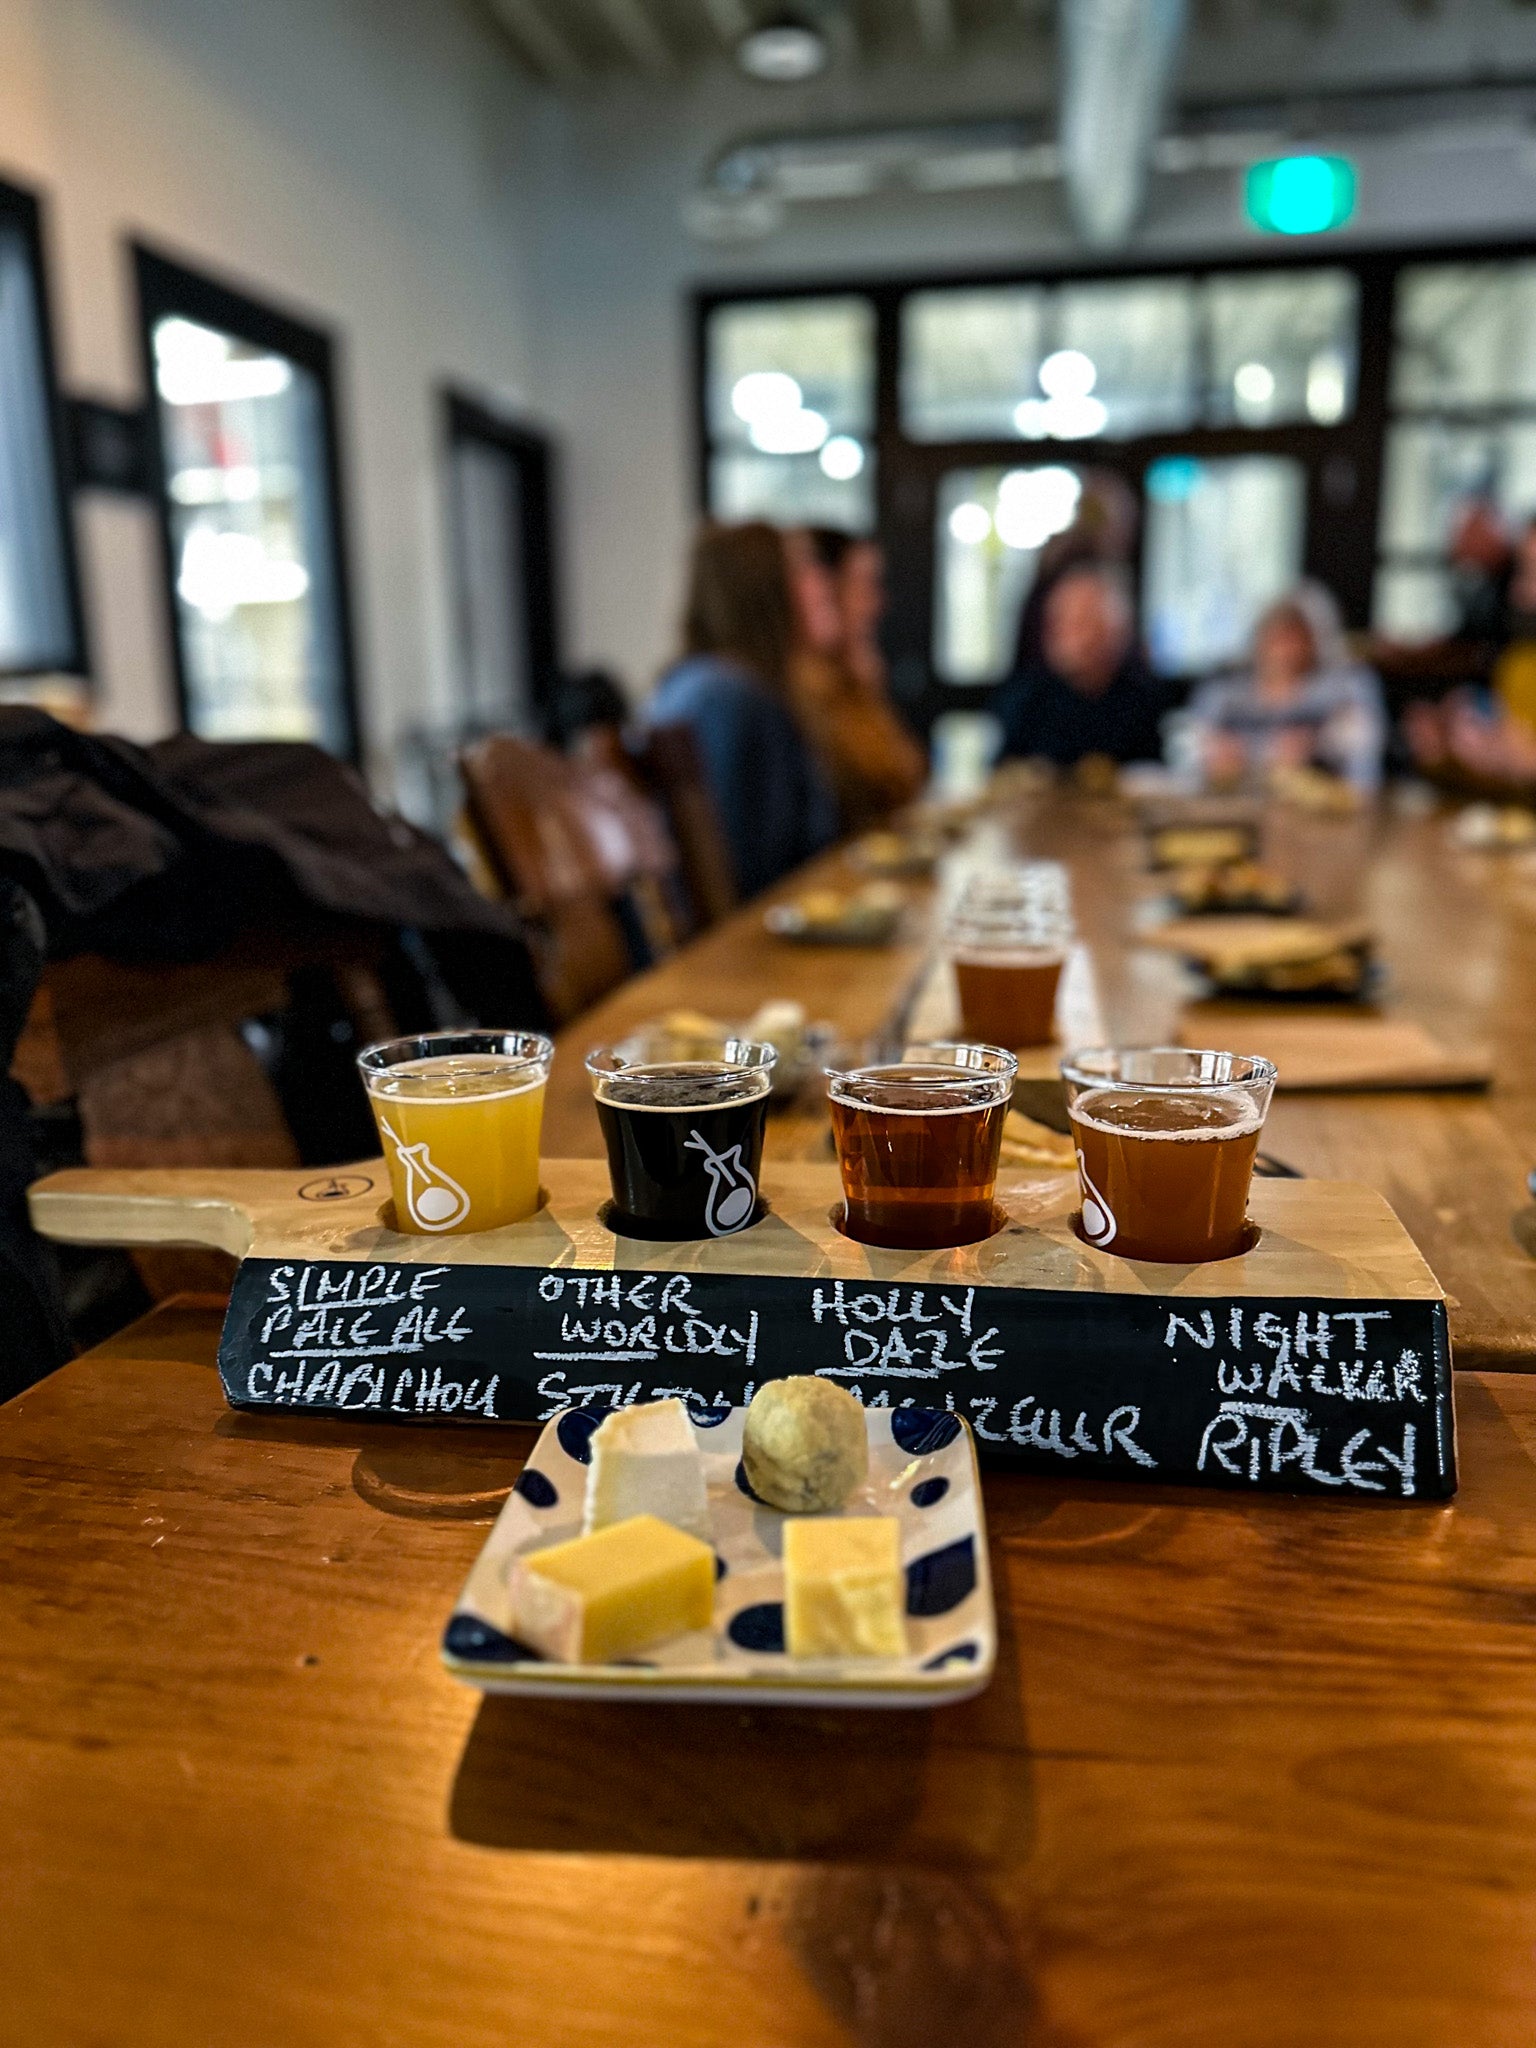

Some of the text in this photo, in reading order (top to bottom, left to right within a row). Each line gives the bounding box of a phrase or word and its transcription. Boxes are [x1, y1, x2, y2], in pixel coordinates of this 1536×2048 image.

[267, 1264, 450, 1304] SIMPLE
[538, 1274, 701, 1315] OTHER
[260, 1303, 473, 1348] PALE ALE
[812, 1281, 975, 1337] HOLLY
[1164, 1306, 1391, 1360] NIGHT
[844, 1326, 1005, 1371] DAZE
[247, 1359, 499, 1418] CHABICHOU
[1197, 1413, 1416, 1496] RIPLEY
